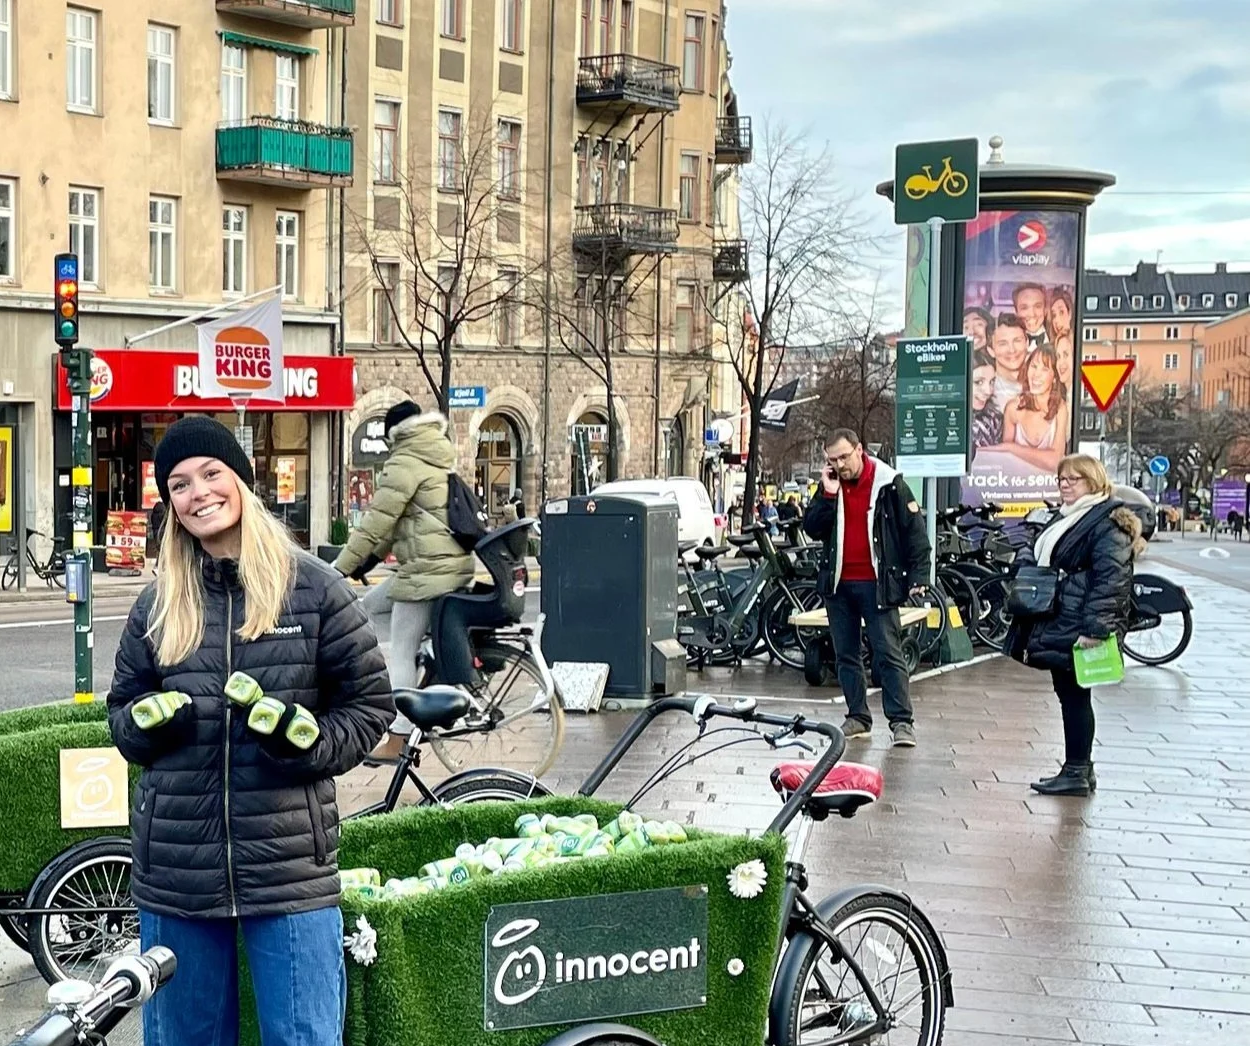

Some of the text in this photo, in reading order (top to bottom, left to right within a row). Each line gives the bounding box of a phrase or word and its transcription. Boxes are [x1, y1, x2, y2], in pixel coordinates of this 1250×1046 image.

[1012, 253, 1050, 266] viaplay
[215, 345, 271, 360] BURGER
[905, 341, 958, 353] Stockholm
[917, 353, 946, 362] eBikes
[216, 359, 272, 378] KING
[283, 367, 318, 398] ING
[967, 471, 1009, 487] tack
[1011, 476, 1026, 487] för
[555, 937, 701, 983] innocent
